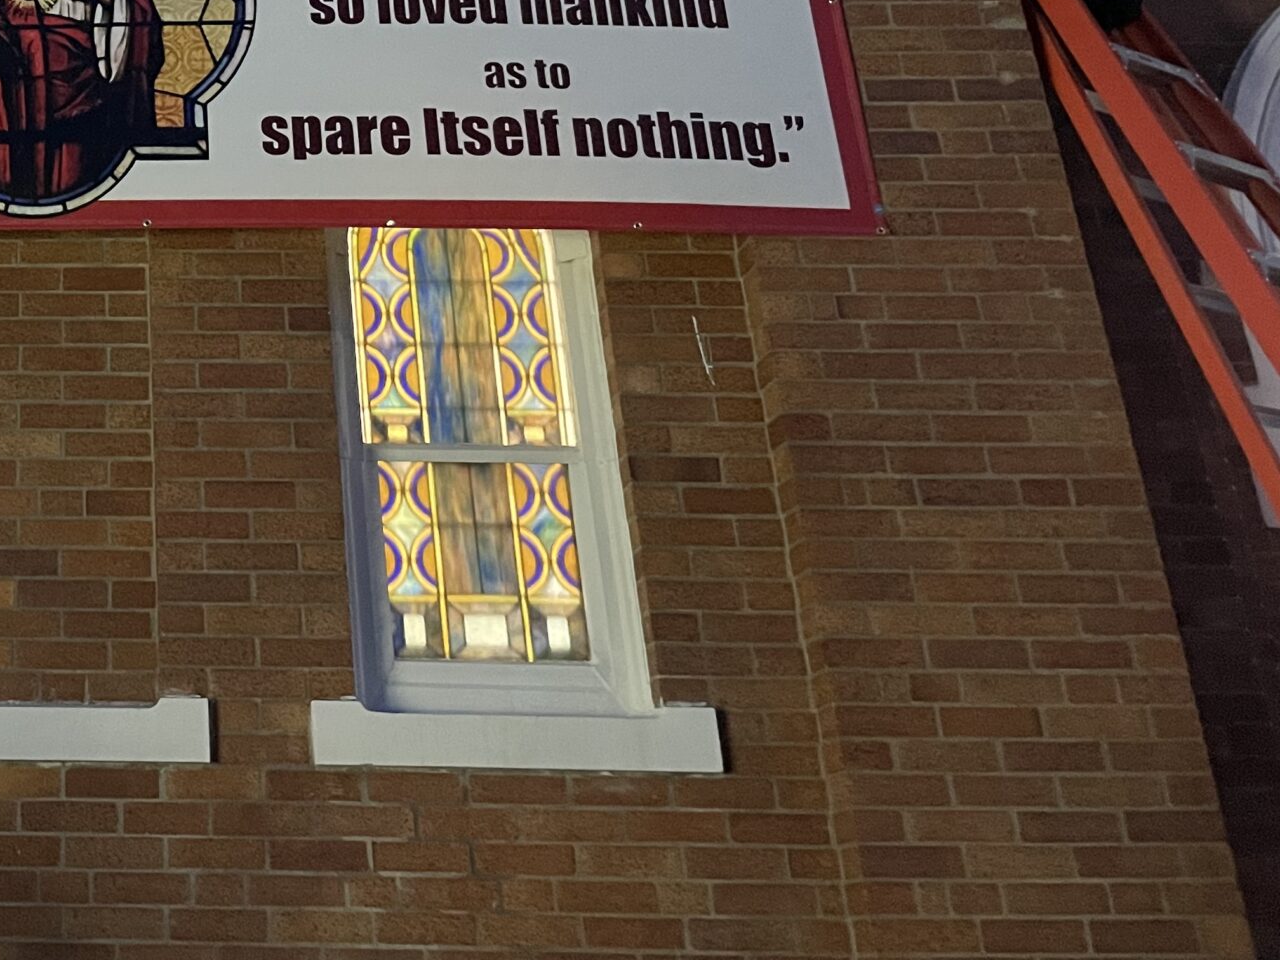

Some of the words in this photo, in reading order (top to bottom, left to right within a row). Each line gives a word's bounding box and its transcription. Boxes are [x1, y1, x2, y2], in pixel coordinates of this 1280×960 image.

[483, 61, 528, 89] as
[533, 59, 571, 90] to
[260, 115, 411, 161] spare
[422, 107, 561, 157] Itself
[571, 111, 804, 169] nothing.”
